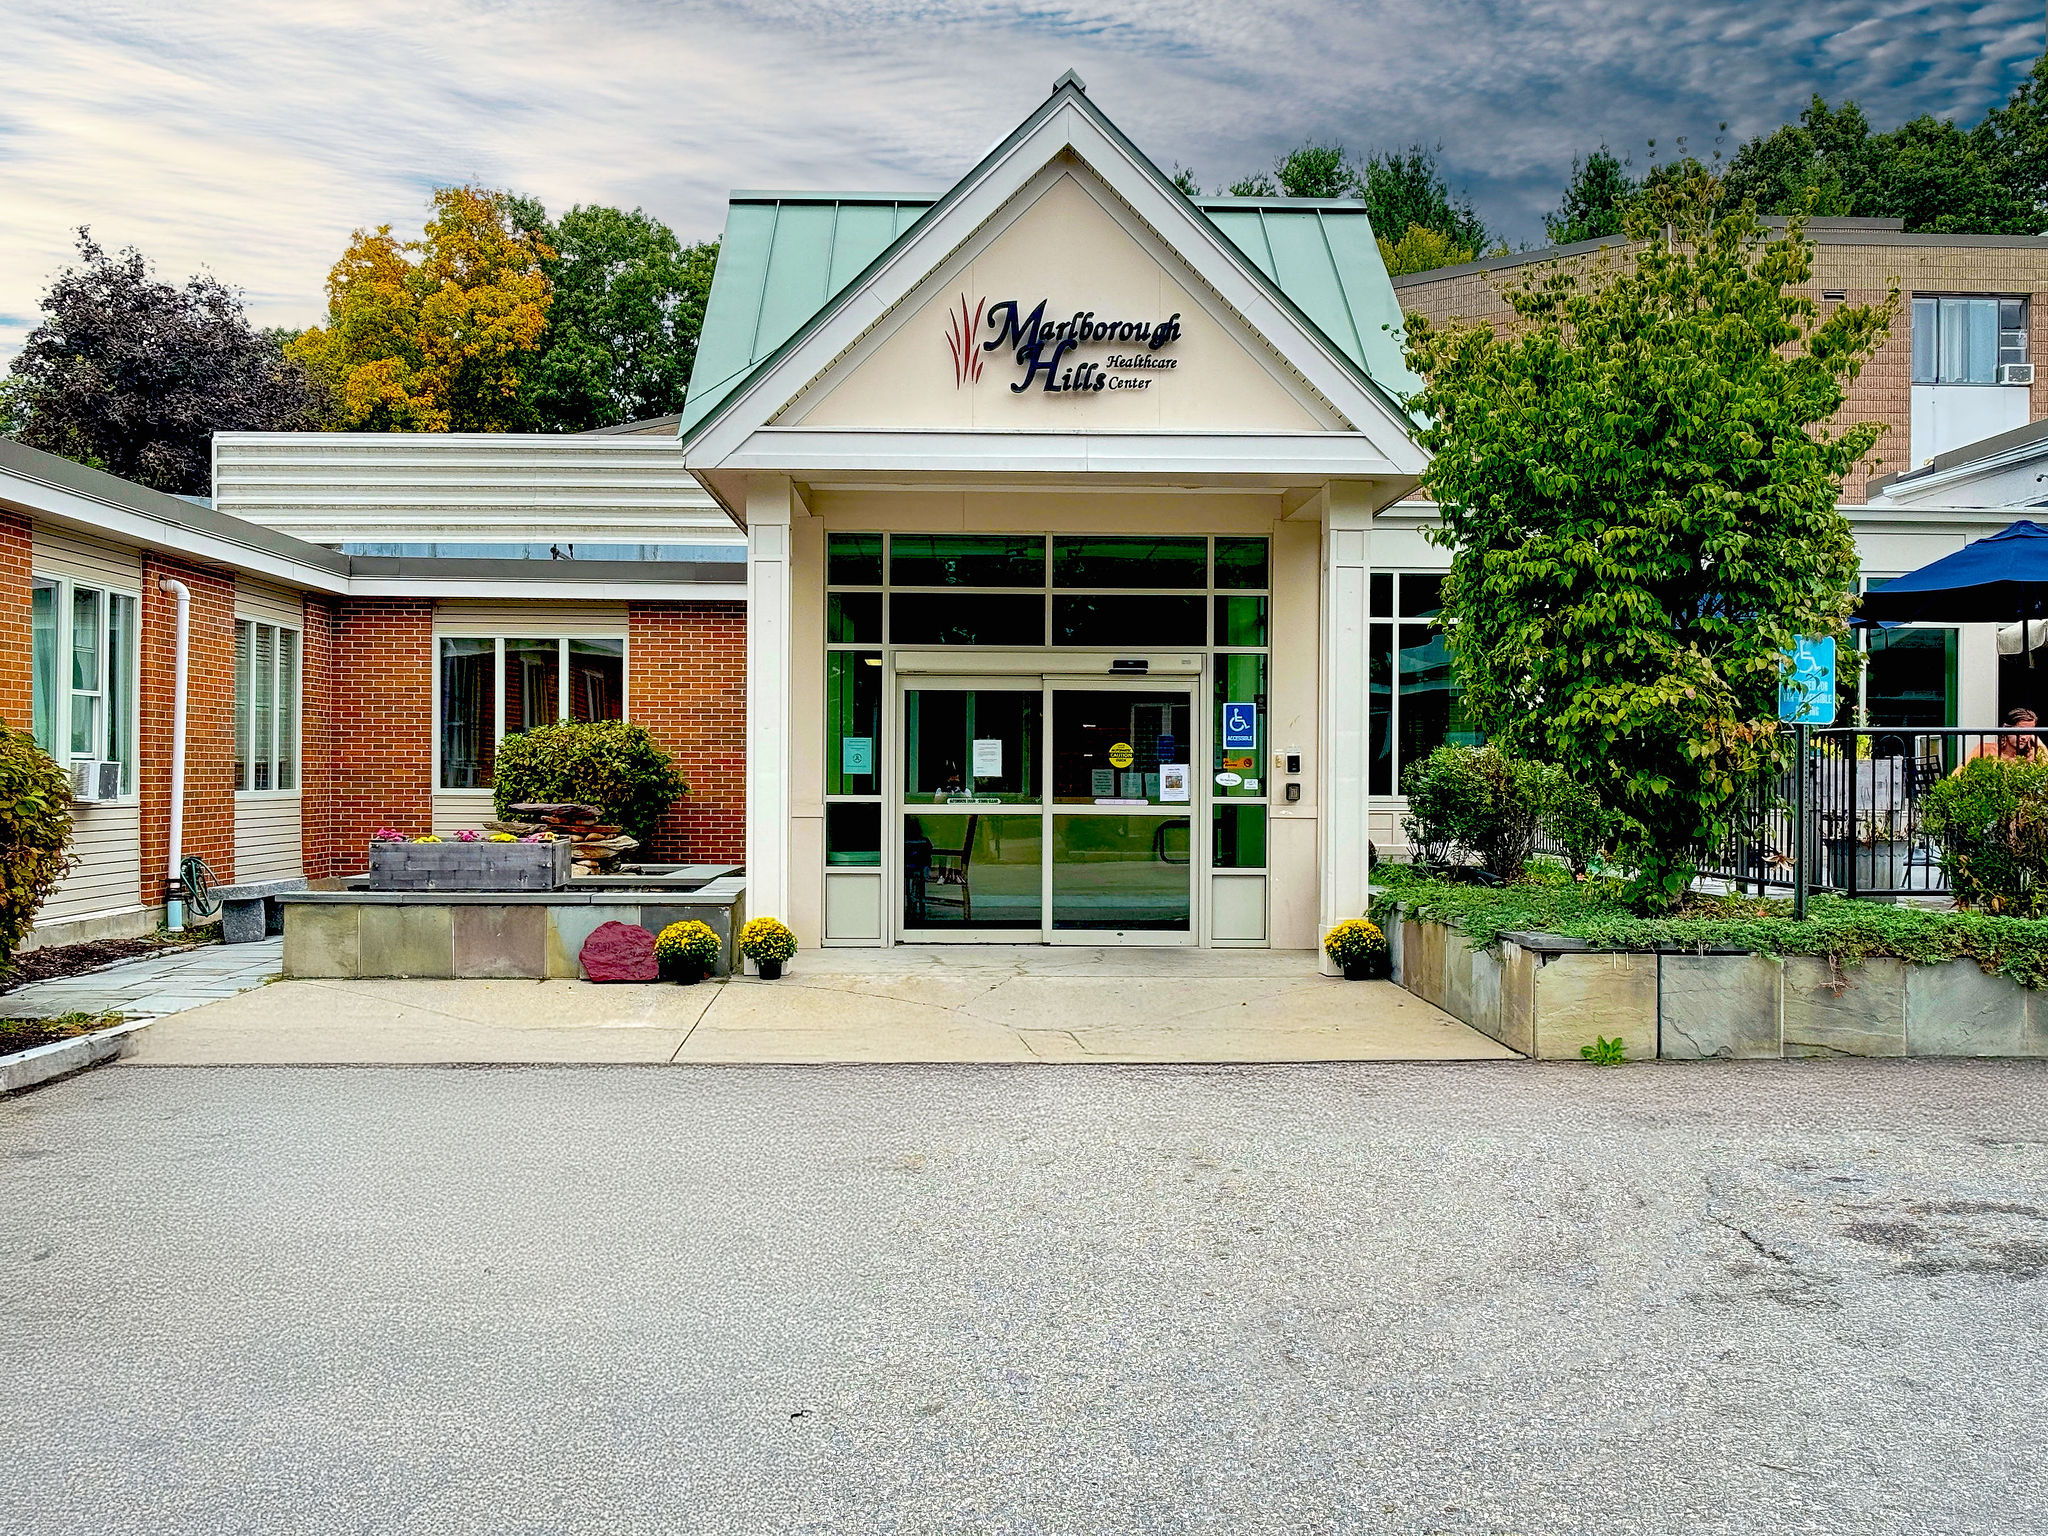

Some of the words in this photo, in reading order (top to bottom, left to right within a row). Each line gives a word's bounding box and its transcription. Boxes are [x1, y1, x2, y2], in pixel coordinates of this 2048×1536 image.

[984, 299, 1181, 350] Marlborough
[1010, 340, 1107, 393] Hills
[1106, 355, 1177, 369] Healthcare
[1108, 376, 1152, 390] Center
